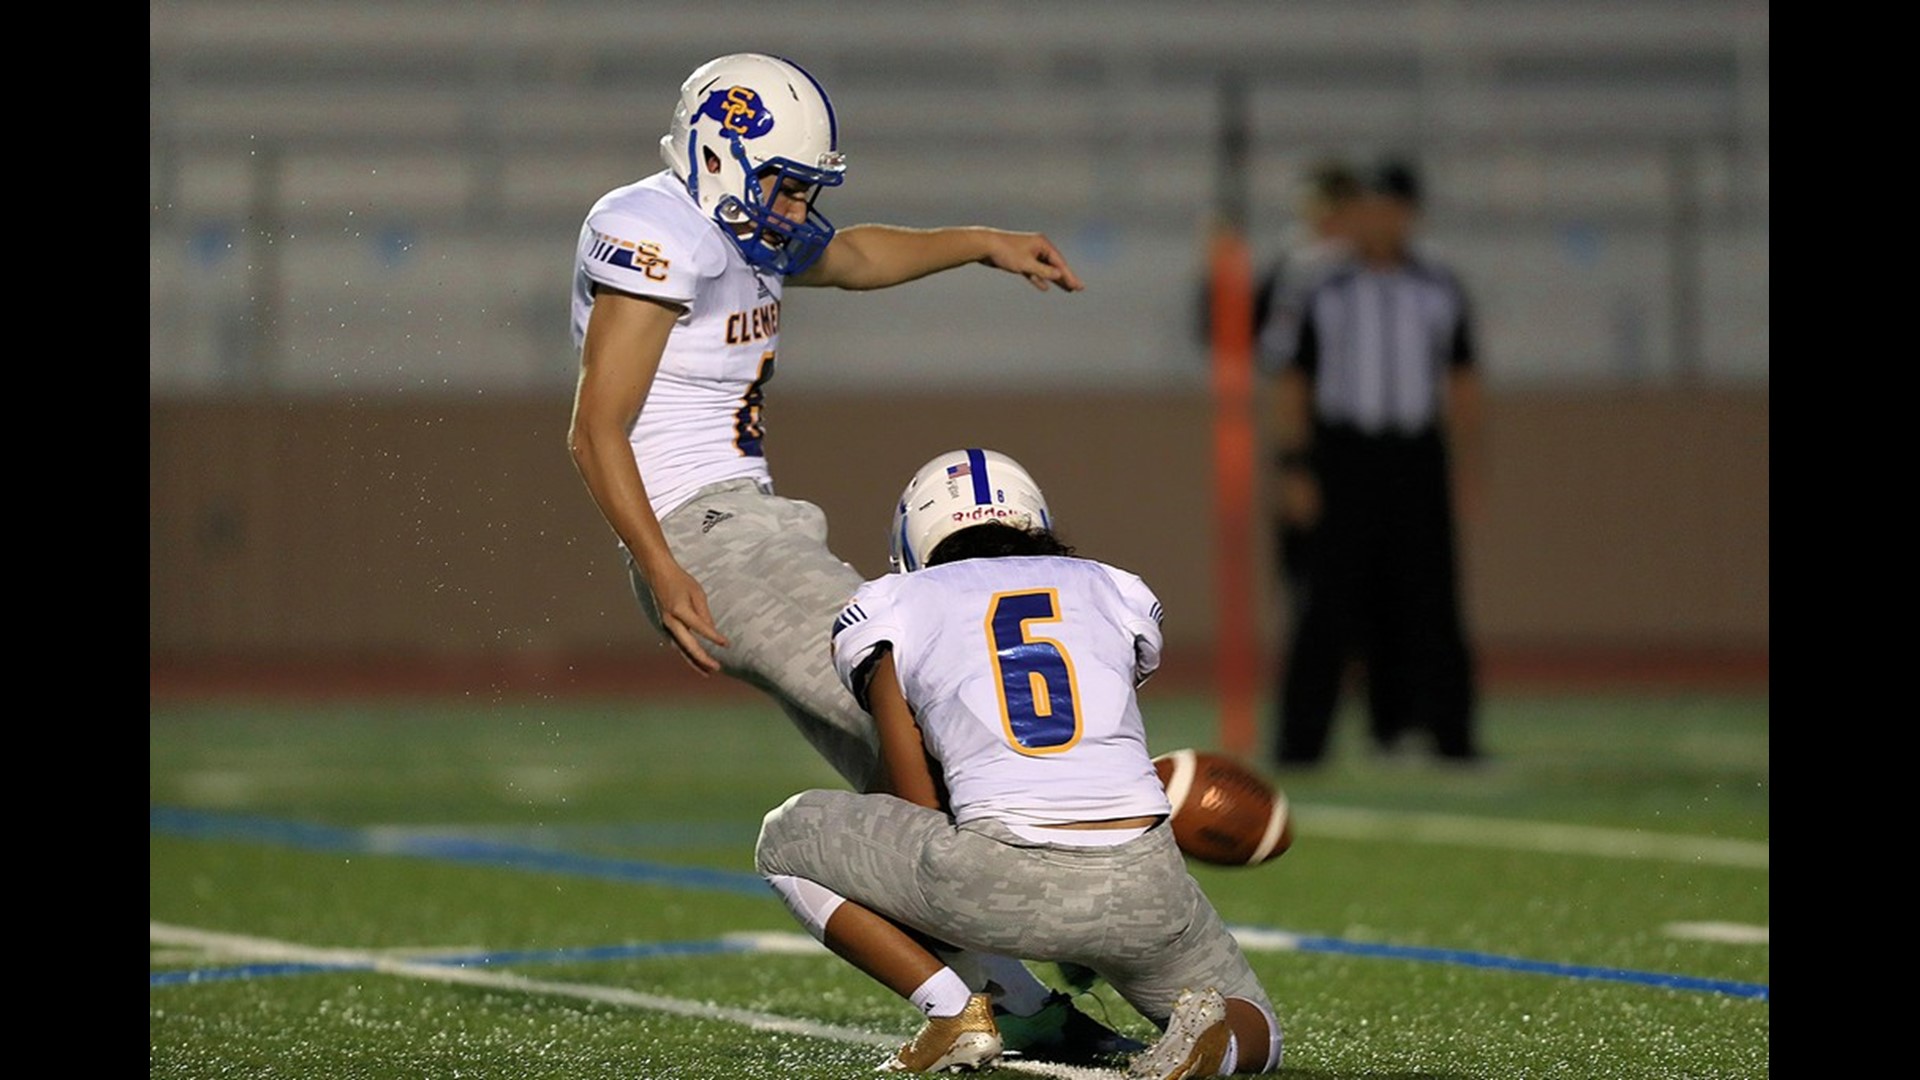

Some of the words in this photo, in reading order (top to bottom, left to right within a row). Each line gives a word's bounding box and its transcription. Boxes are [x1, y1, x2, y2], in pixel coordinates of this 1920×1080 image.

[721, 85, 755, 134] SC
[636, 239, 670, 282] SC
[726, 303, 781, 344] CLEME
[952, 507, 1018, 522] Riddel
[985, 588, 1083, 757] 6
